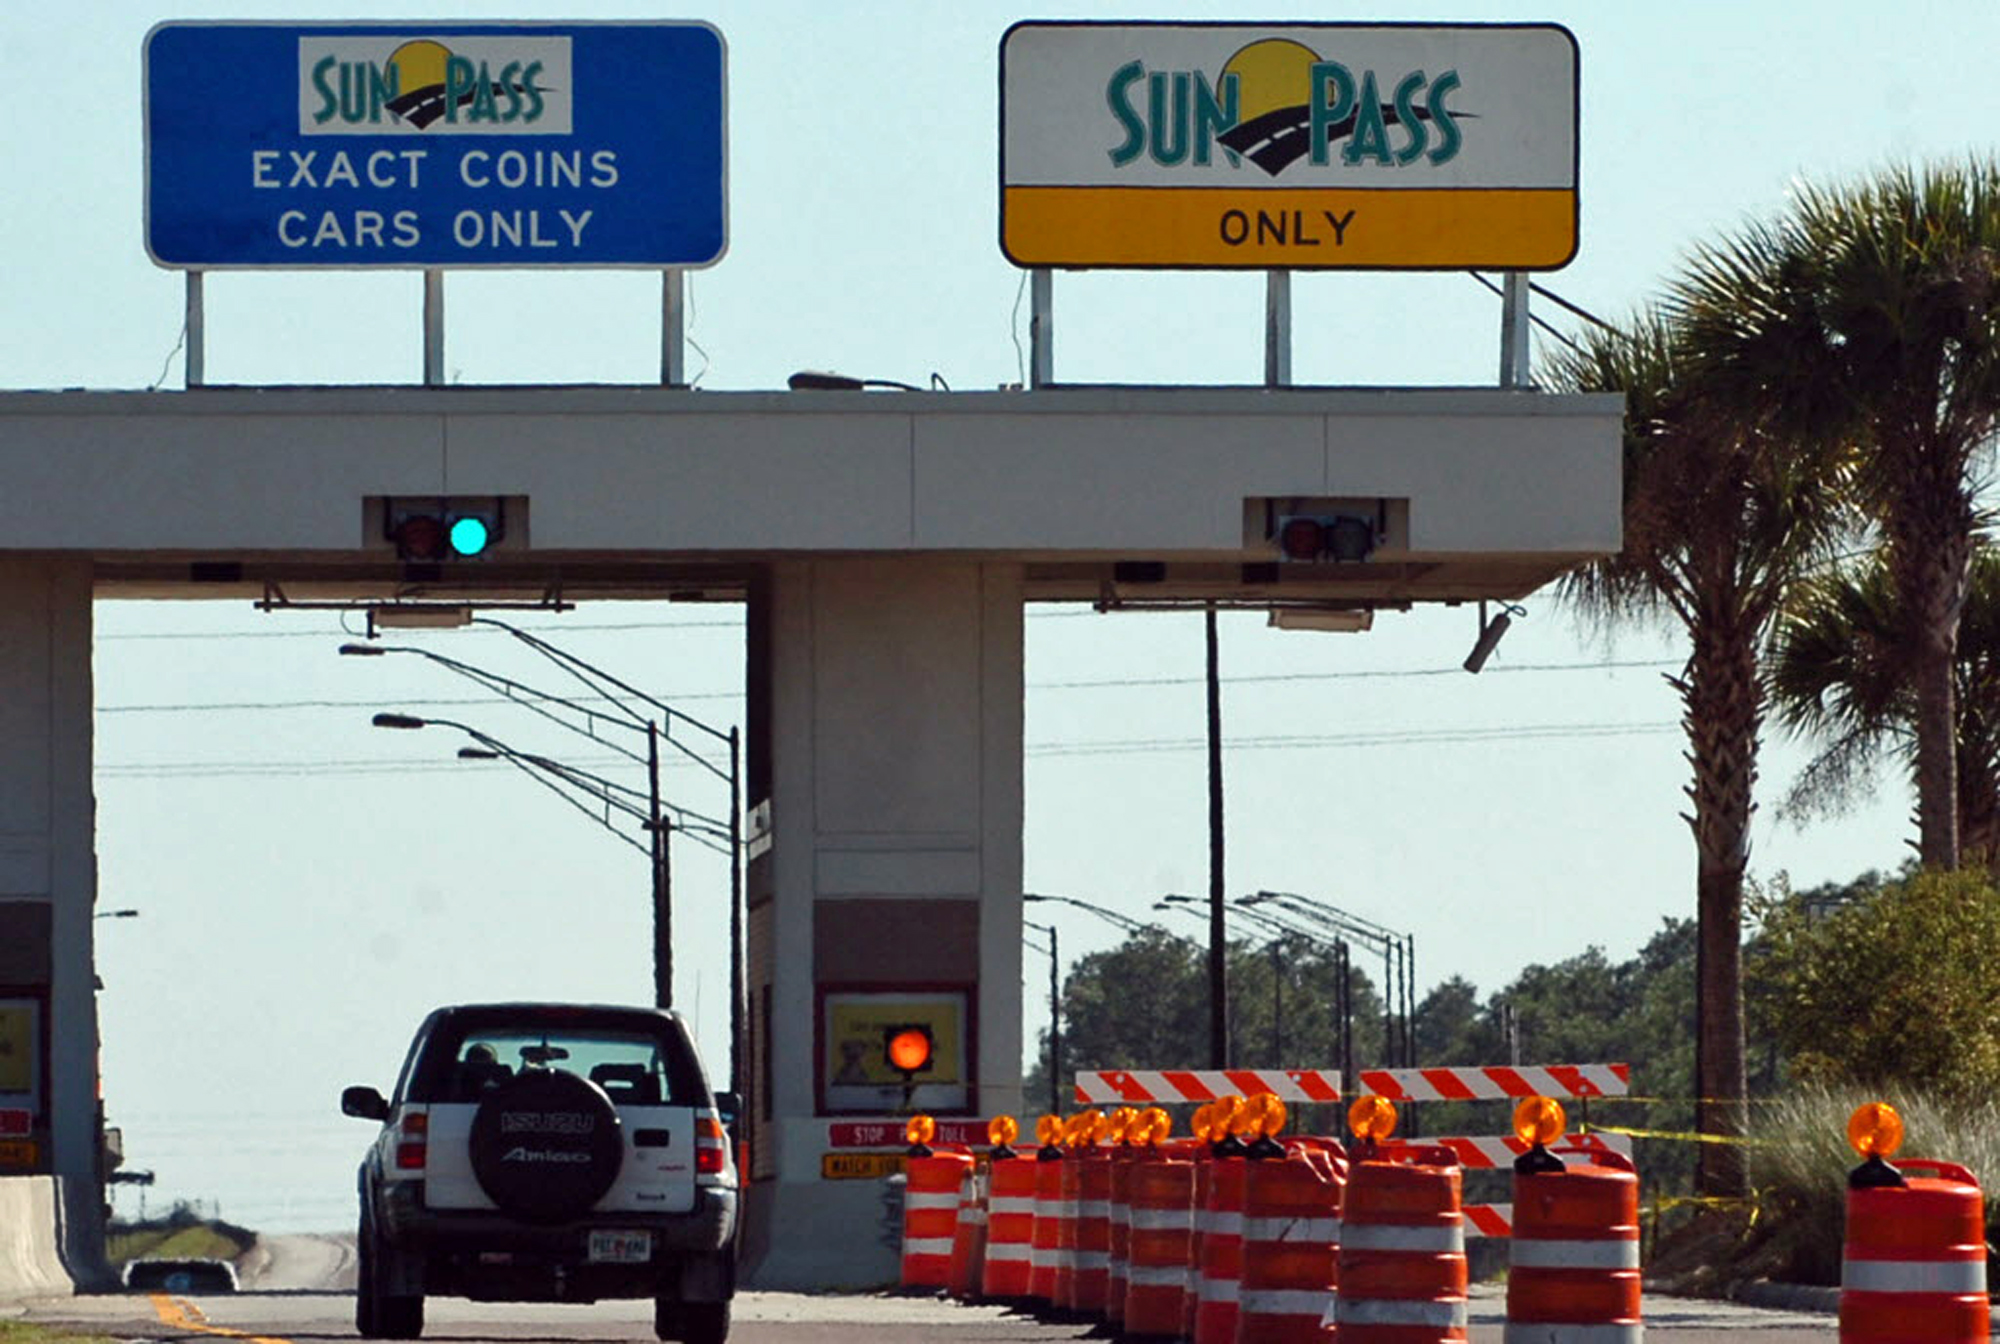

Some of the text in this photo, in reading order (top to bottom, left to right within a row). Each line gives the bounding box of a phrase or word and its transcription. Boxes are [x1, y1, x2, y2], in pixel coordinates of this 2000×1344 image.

[311, 54, 545, 125] SUN PASS
[1106, 59, 1464, 168] SUN PASS
[252, 150, 620, 188] EXACT COINS
[277, 210, 594, 247] CARS ONLY
[1219, 209, 1357, 246] ONLY
[501, 1112, 595, 1134] ISUZU
[854, 1126, 886, 1143] STOP
[938, 1126, 968, 1142] TOLL
